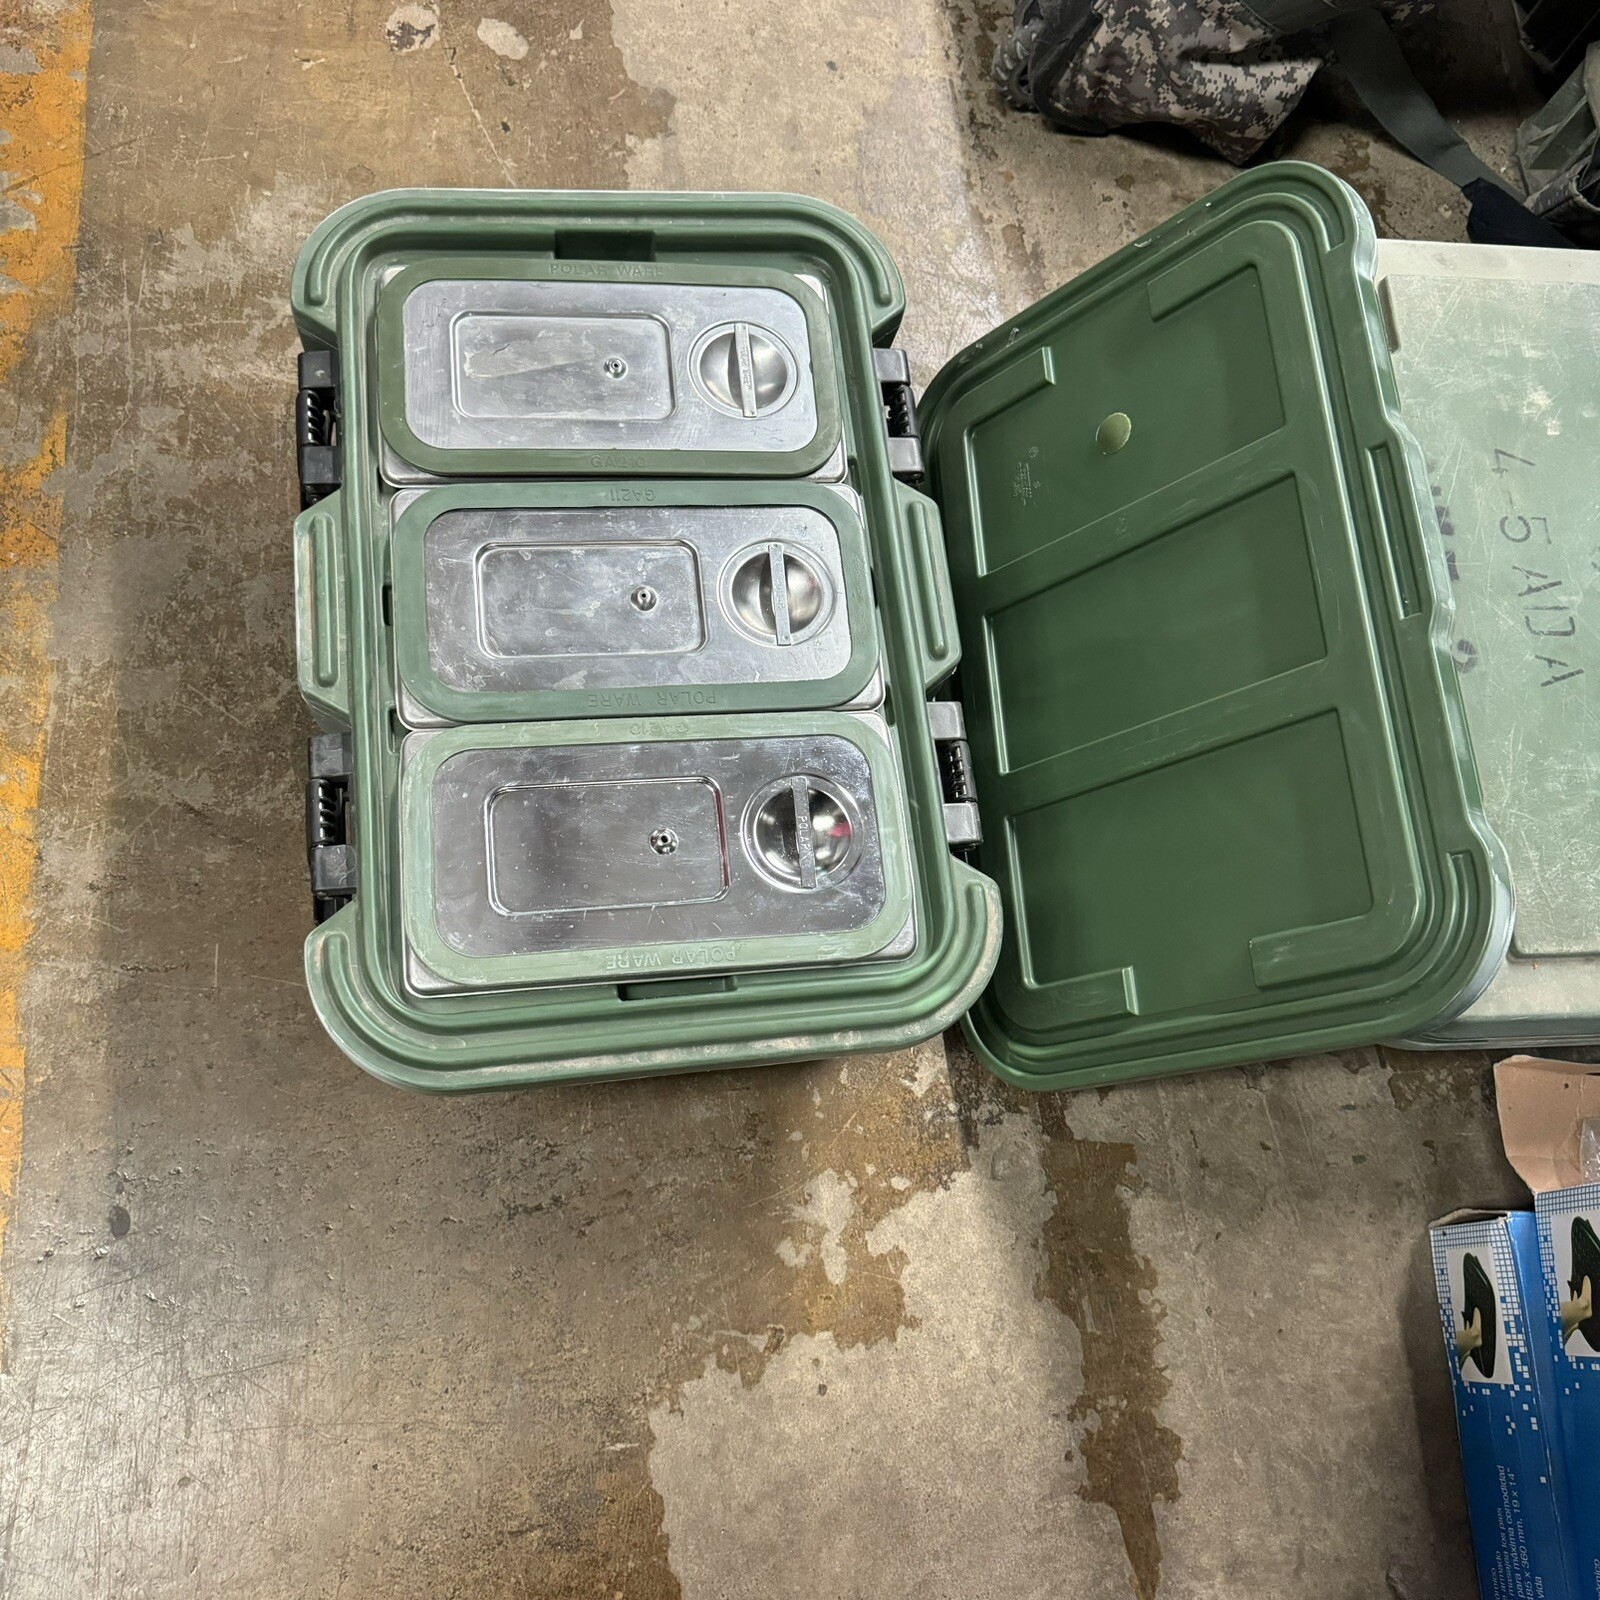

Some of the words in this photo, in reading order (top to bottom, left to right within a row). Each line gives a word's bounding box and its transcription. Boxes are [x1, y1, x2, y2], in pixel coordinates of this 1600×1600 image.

[550, 263, 607, 275] POLAR
[617, 264, 664, 277] WARE
[610, 488, 656, 502] GA211
[588, 692, 641, 708] WARE
[656, 690, 716, 705] POLAR
[606, 952, 661, 969] WARE
[671, 945, 736, 964] POLAR
[1497, 1465, 1513, 1525] comodidad
[1512, 1499, 1520, 1513] 19
[1507, 1527, 1520, 1570] máxima
[1519, 1545, 1530, 1568] 360
[1514, 1573, 1525, 1598] para
[1534, 1576, 1545, 1599] vida
